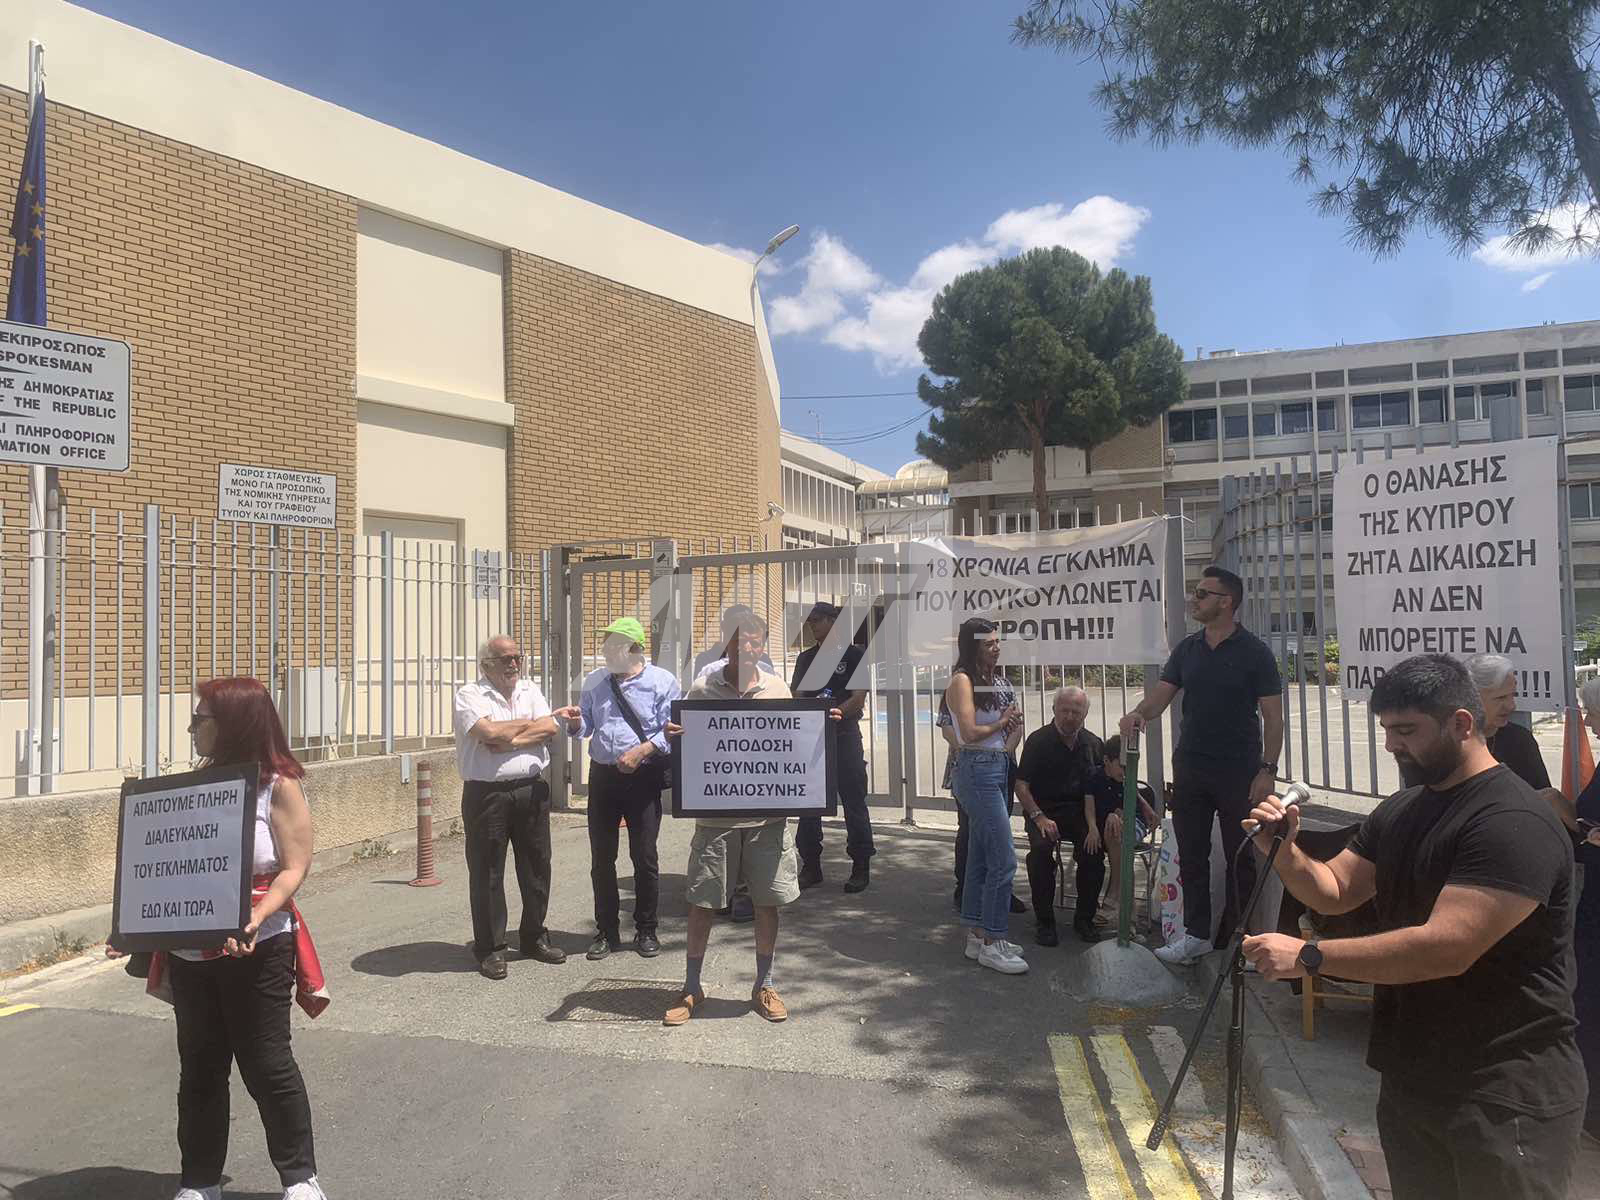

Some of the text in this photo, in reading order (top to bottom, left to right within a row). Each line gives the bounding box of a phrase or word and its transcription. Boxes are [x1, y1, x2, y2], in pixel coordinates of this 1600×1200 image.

[0, 331, 106, 358] ΕΚΠΡΟΣΩΠΟΣ
[24, 380, 114, 402] ΔΗΜΟΚΡΑΤΙΑΣ
[14, 396, 40, 410] THE
[53, 401, 116, 419] REPUBLIC
[16, 424, 115, 445] ΠΛΗΡΟΦΟΡΙΩΝ
[60, 446, 106, 460] OFFICE
[231, 478, 325, 494] ΜΟΝΟ ΓΙΑ ΠΡΟΣΩΠΙΚΟ
[235, 468, 322, 484] ΧΩΡΟΣ ΣΤΑΘΜΕΥΣΗΣ
[1364, 455, 1507, 498] Ο ΘΑΝΑΣΗΣ
[225, 487, 331, 504] ΤΗΣ ΝΟΜΙΚΗΣ ΥΠΗΡΕΣΙΑΣ
[238, 500, 316, 513] ΚΑΙ ΤΟΥ ΓΡΑΦΕΙΟΥ
[221, 509, 333, 525] ΤΥΠΟΥ ΚΑΙ ΠΛΗΡΟΦΟΡΙΩΝ
[1359, 497, 1515, 537] ΤΗΣ ΚΥΠΡΟΥ
[926, 543, 1155, 579] 18 ΧΡΟΝΙΑ ΕΓΚΛΗΜΑ
[1347, 538, 1536, 576] ΖΗΤΑ ΔΙΚΑΙΩΣΗ
[915, 579, 1161, 612] ΠΟΥ ΚΟΥΚΟΥΛΩΝΕΤΑΙ
[1392, 584, 1483, 613] ΑΝ ΔΕΝ
[1359, 626, 1527, 654] ΜΠΟΡΕΙΤΕ ΝΑ
[707, 717, 800, 730] ΑΠΑΙΤΟΥΜΕ
[716, 739, 793, 752] ΑΠΟΔΟΣΗ
[703, 761, 806, 775] ΕΥΘΥΝΩΝ ΚΑΙ
[703, 783, 806, 797] ΔΙΚΑΙΟΣΥΝΗΣ
[133, 789, 238, 817] ΑΠΑΙΤΟΥΜΕ ΠΛΗΡΗ
[145, 823, 218, 846] ΔΙΑΛΕΥΚΑΝΣΗ
[134, 856, 229, 879] ΤΟΥ ΕΓΚΛΗΜΑΤΟΣ
[141, 900, 214, 919] ΕΔΩ ΚΑΙ ΤΩΡΑ
